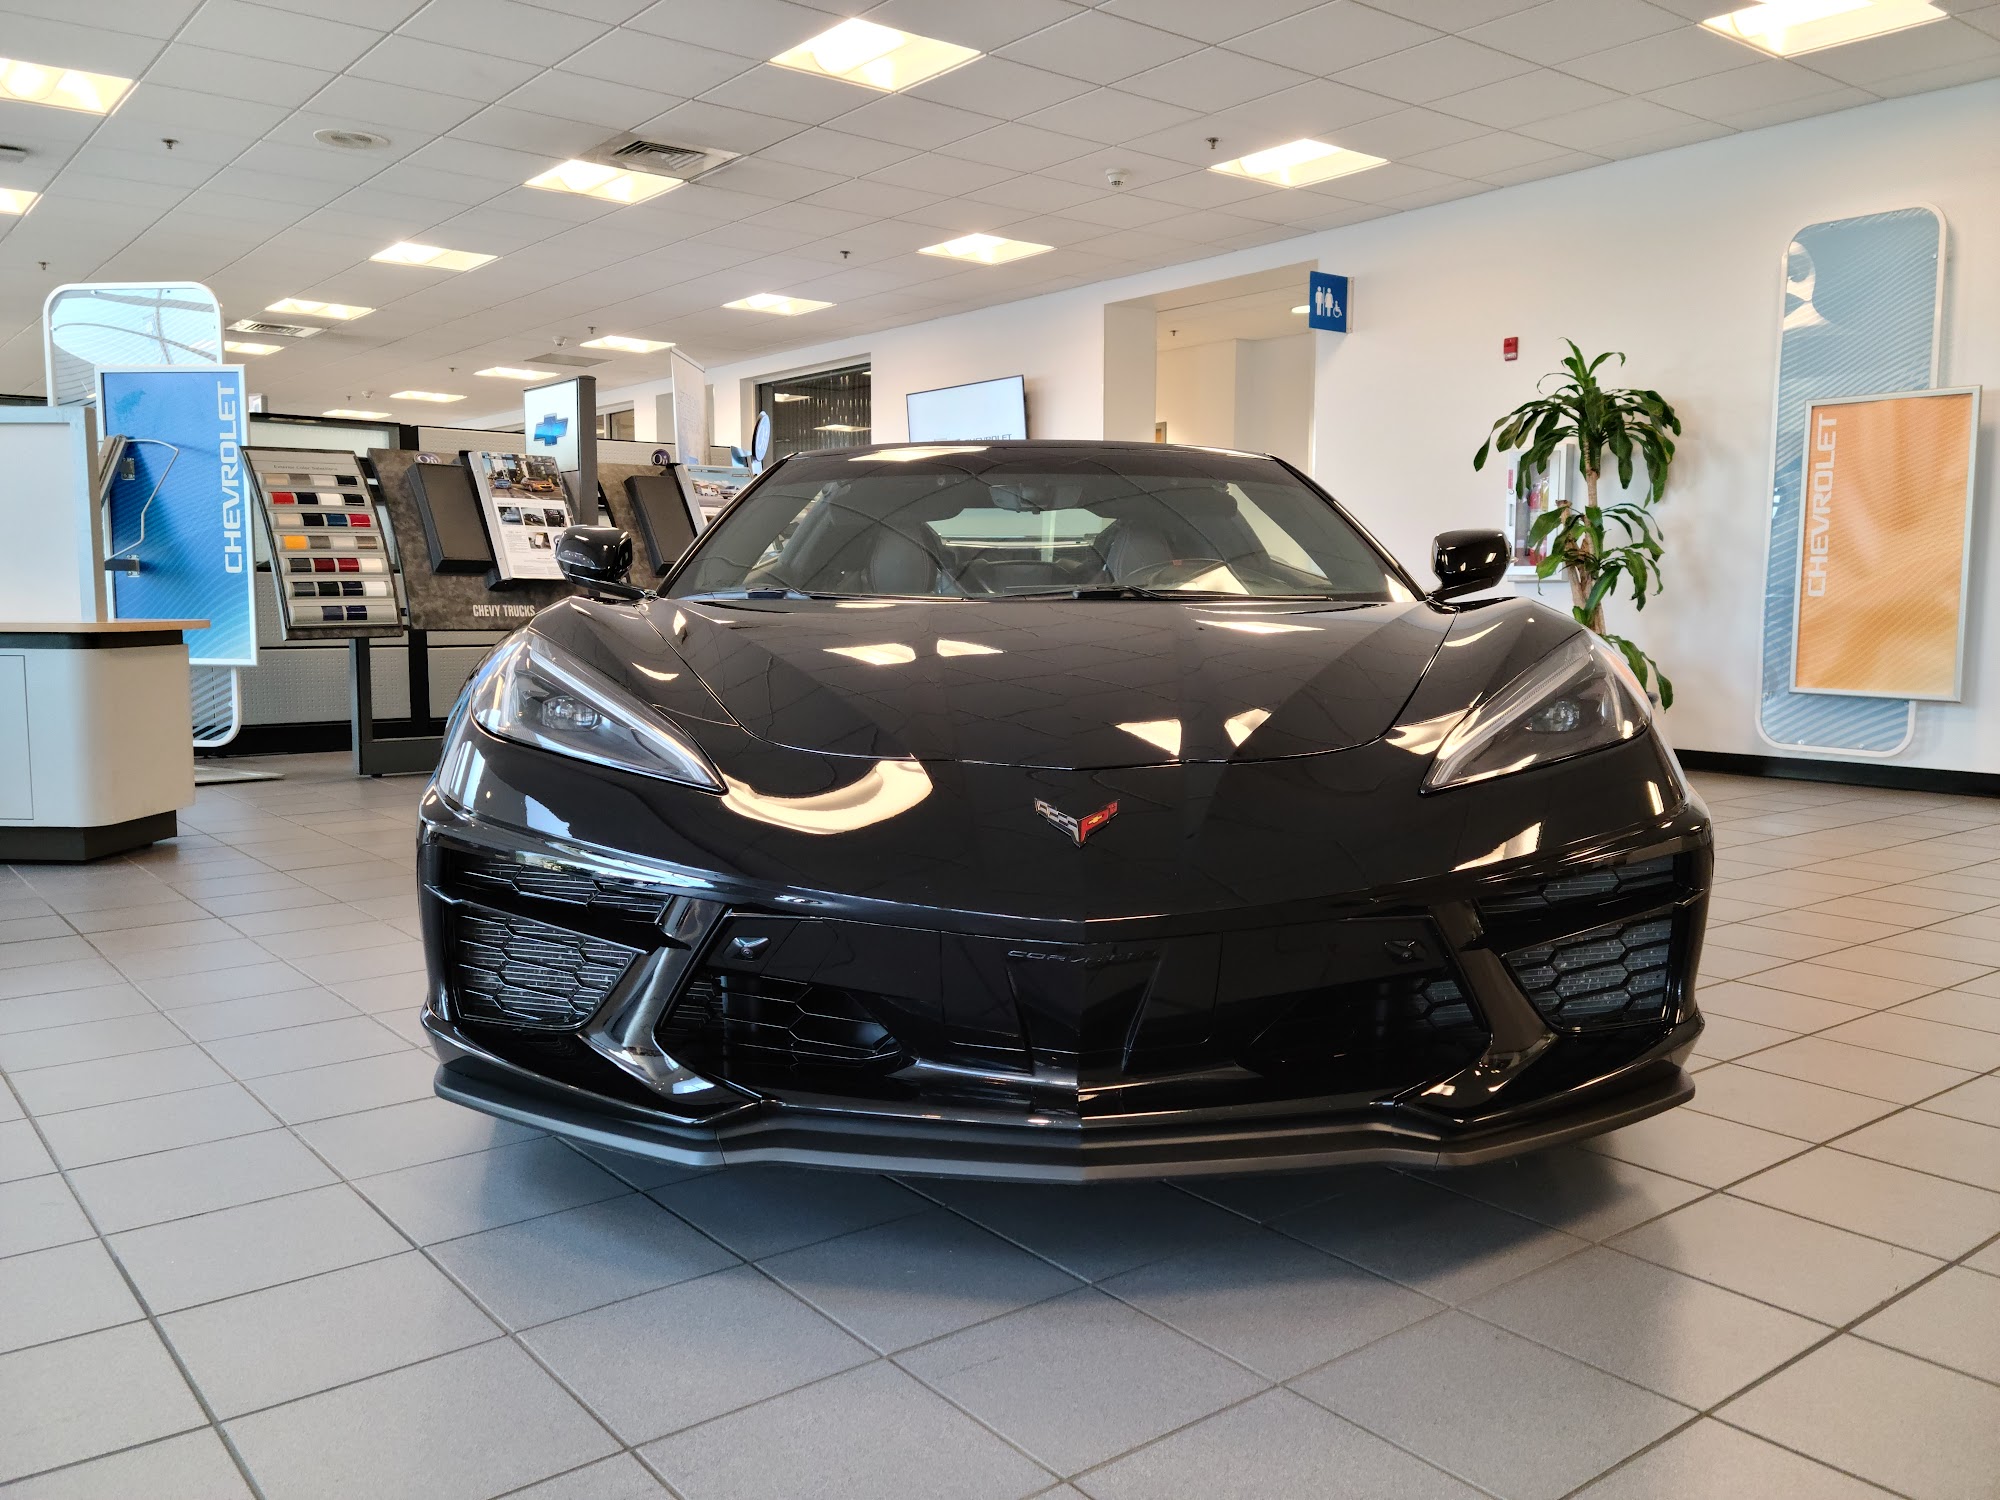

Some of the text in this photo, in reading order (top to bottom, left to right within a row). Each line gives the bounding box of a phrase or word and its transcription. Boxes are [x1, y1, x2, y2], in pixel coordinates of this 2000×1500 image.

[217, 381, 243, 574] CHEVROLET
[1807, 413, 1838, 597] CHEVROLET
[472, 604, 536, 617] CHEVY TRUCKS
[1007, 949, 1158, 963] CORV
